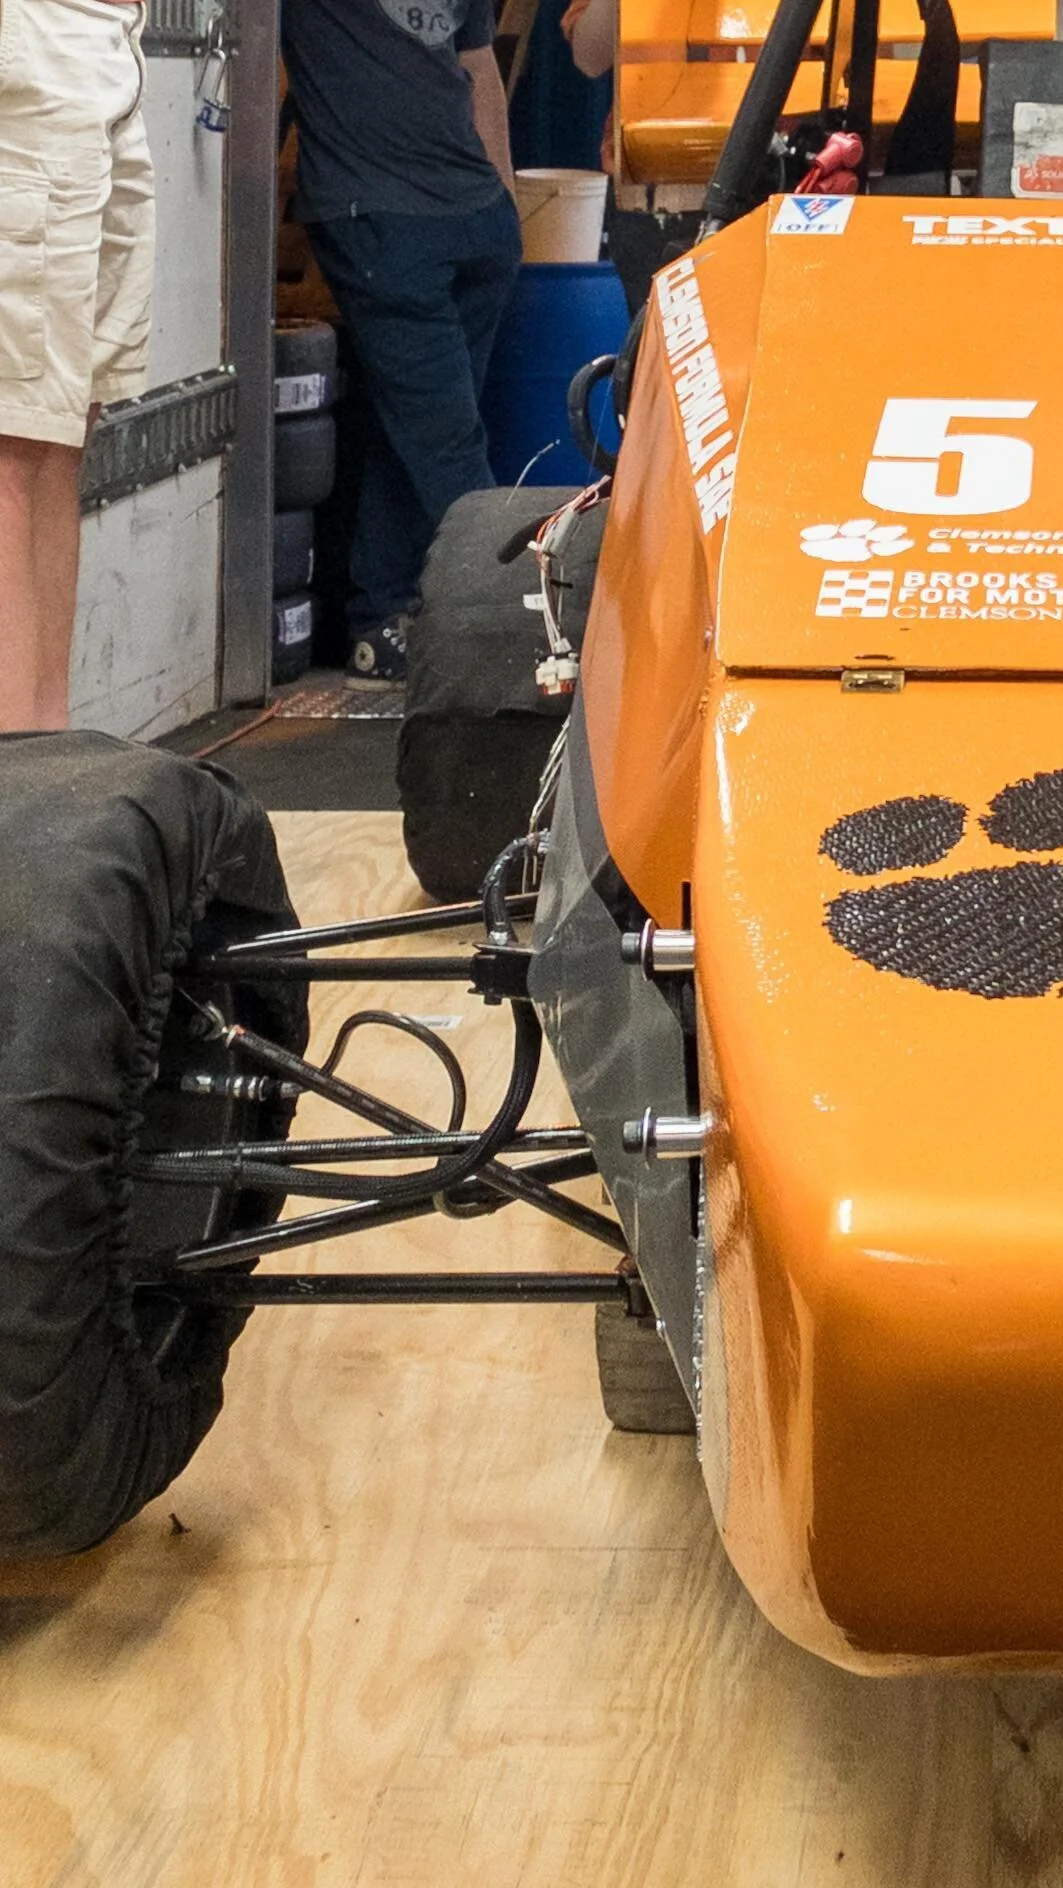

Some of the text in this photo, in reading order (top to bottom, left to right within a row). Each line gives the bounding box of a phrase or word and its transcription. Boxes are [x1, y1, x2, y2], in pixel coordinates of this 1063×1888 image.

[786, 223, 831, 232] OFF
[655, 256, 736, 536] CLEMSON FORMULA SAE
[926, 541, 952, 553] &
[903, 571, 1058, 590] BROOKS
[898, 587, 971, 605] FOR
[892, 606, 1063, 621] CLEMSON
